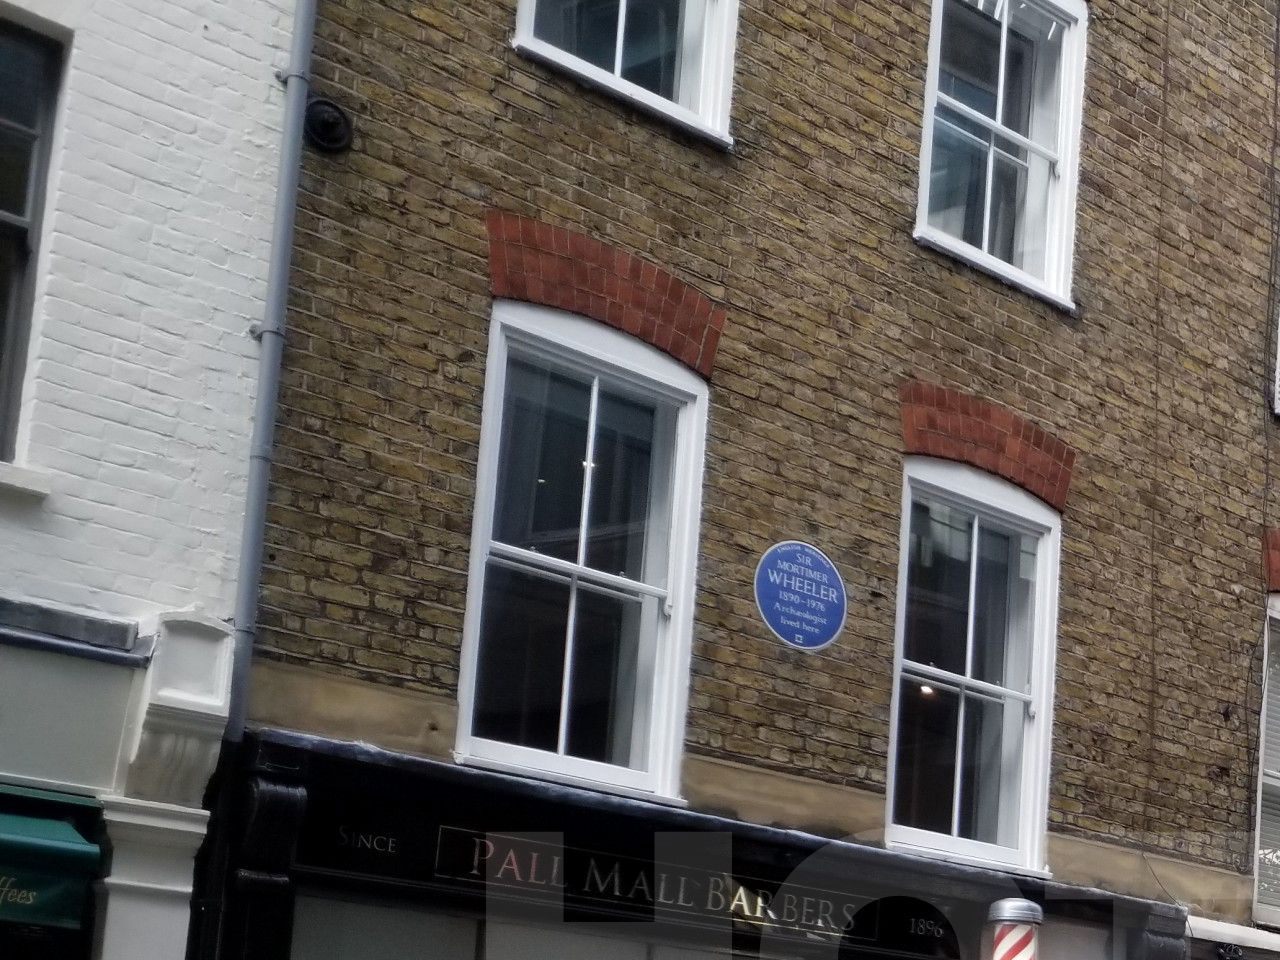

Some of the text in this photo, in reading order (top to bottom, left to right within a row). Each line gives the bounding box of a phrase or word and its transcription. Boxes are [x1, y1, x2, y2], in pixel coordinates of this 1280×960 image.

[796, 554, 813, 567] SIR
[777, 560, 828, 584] MORTIMER
[767, 569, 839, 604] WHEELER
[780, 616, 821, 634] lived here
[469, 837, 857, 933] PALL MALL BARBERS
[908, 917, 946, 938] 1896
